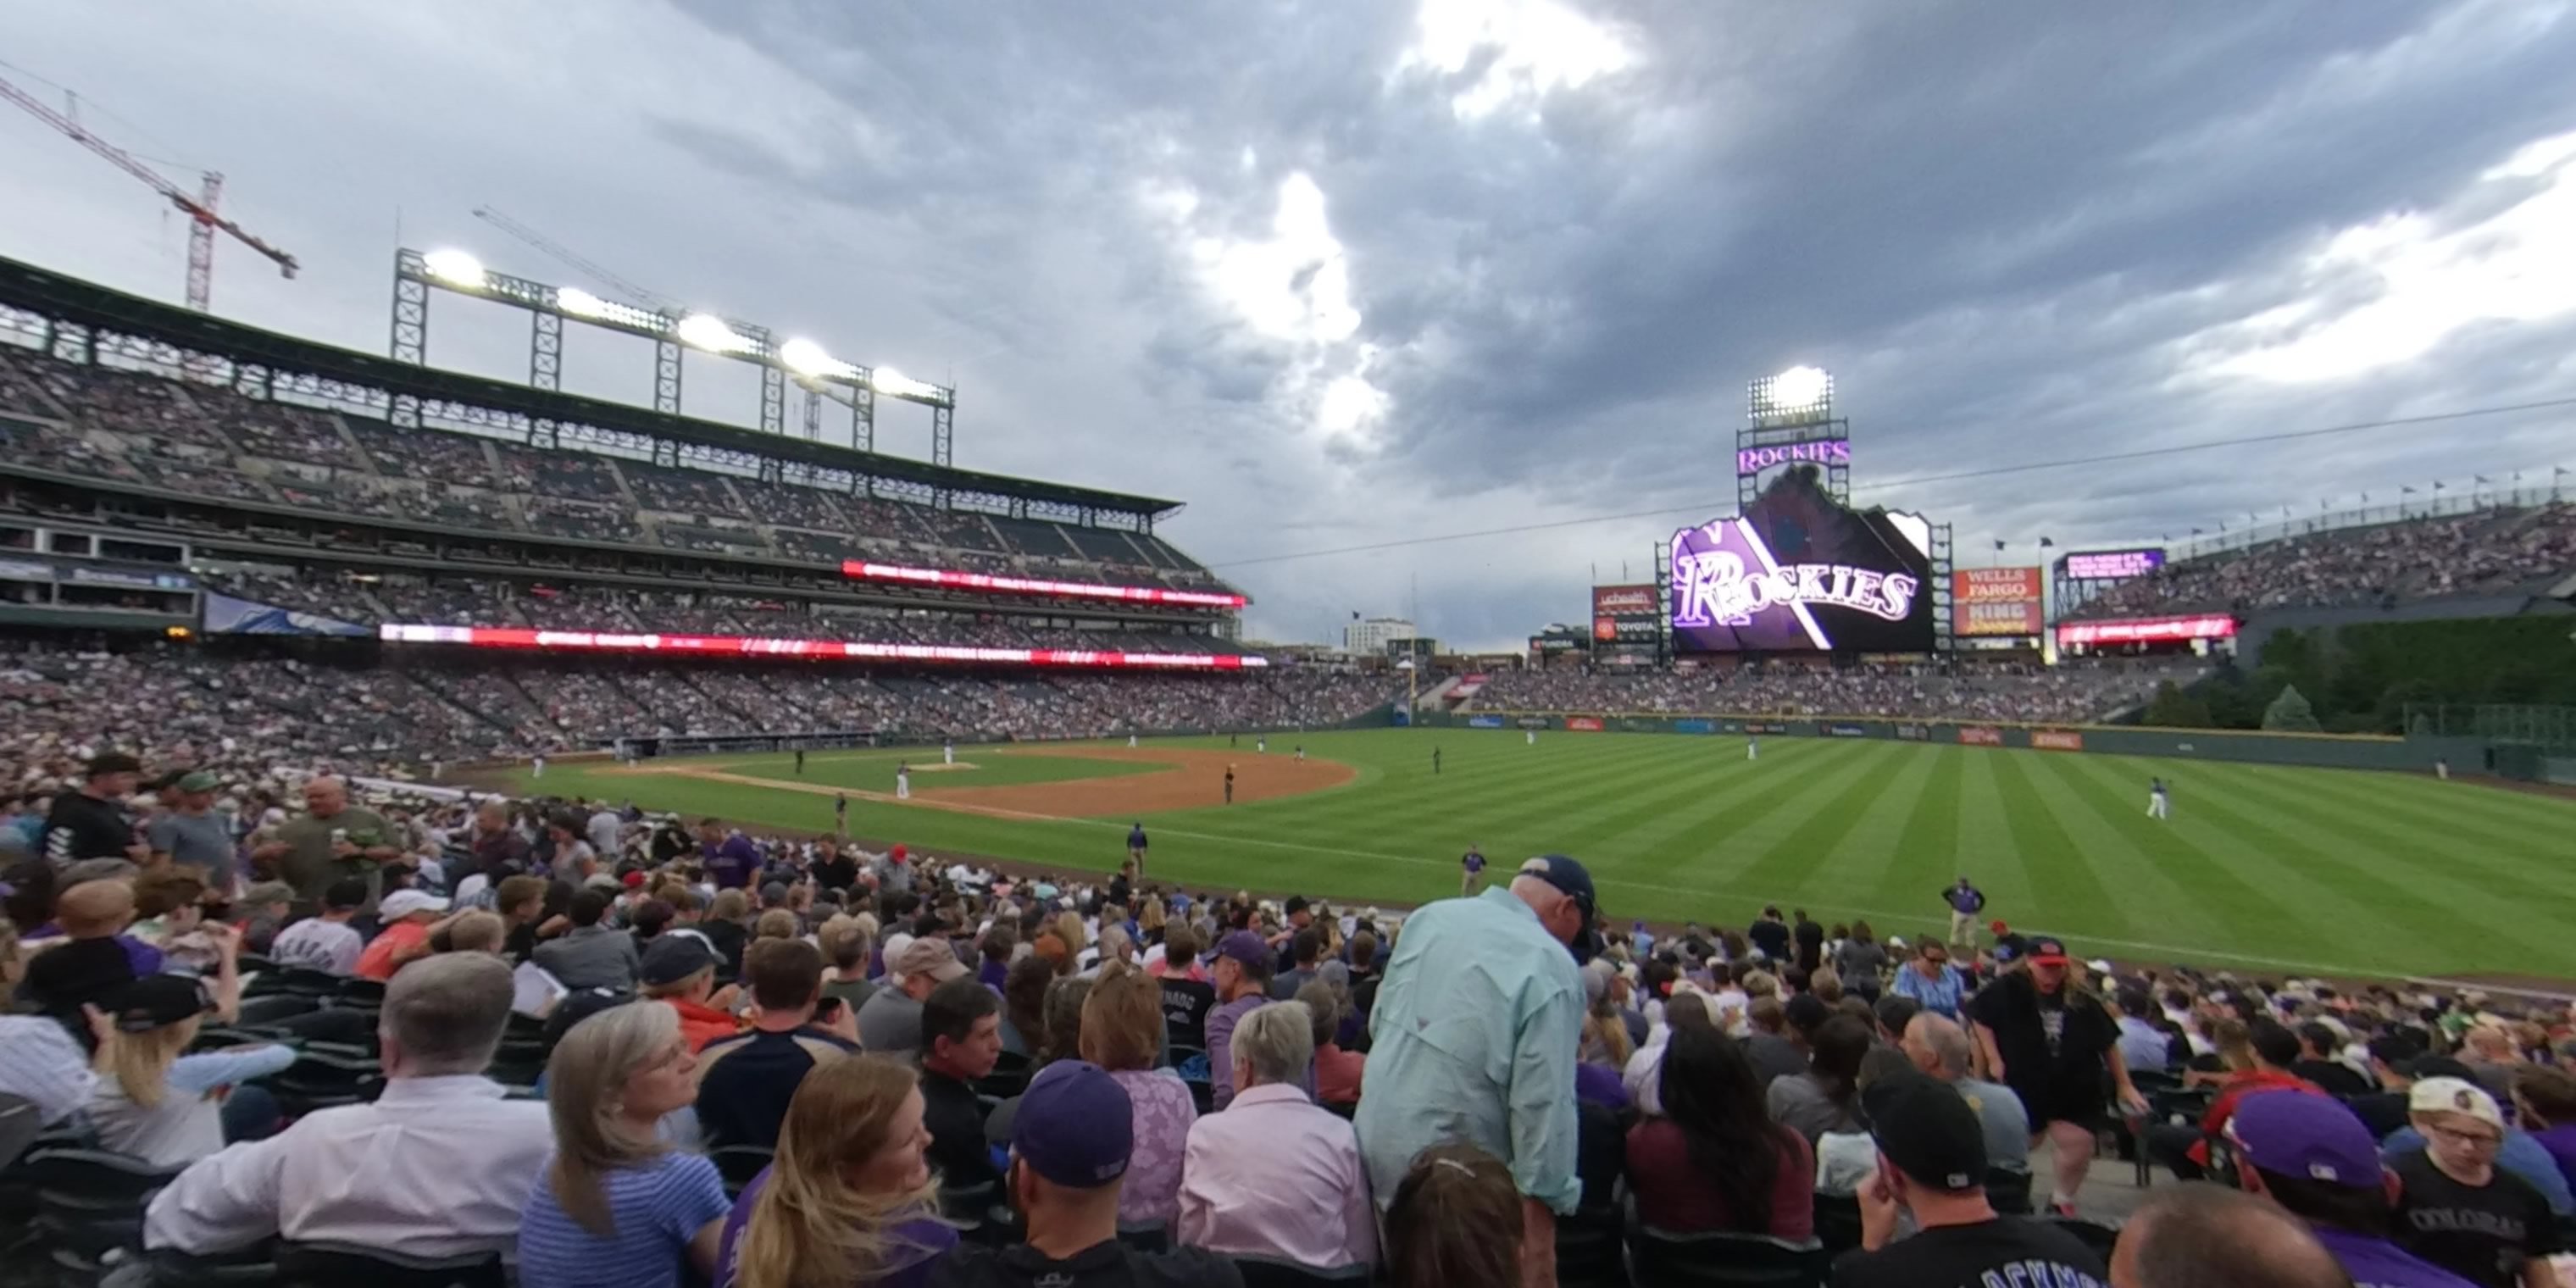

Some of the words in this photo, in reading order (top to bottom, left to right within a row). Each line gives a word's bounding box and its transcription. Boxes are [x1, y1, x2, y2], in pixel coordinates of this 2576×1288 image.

[1738, 440, 1850, 475] ROCKIES
[1968, 569, 2027, 583] WELLS
[1712, 564, 1918, 621] ROCKIES
[1968, 582, 2028, 597] FARGO
[1615, 621, 1656, 632] TOYOTA
